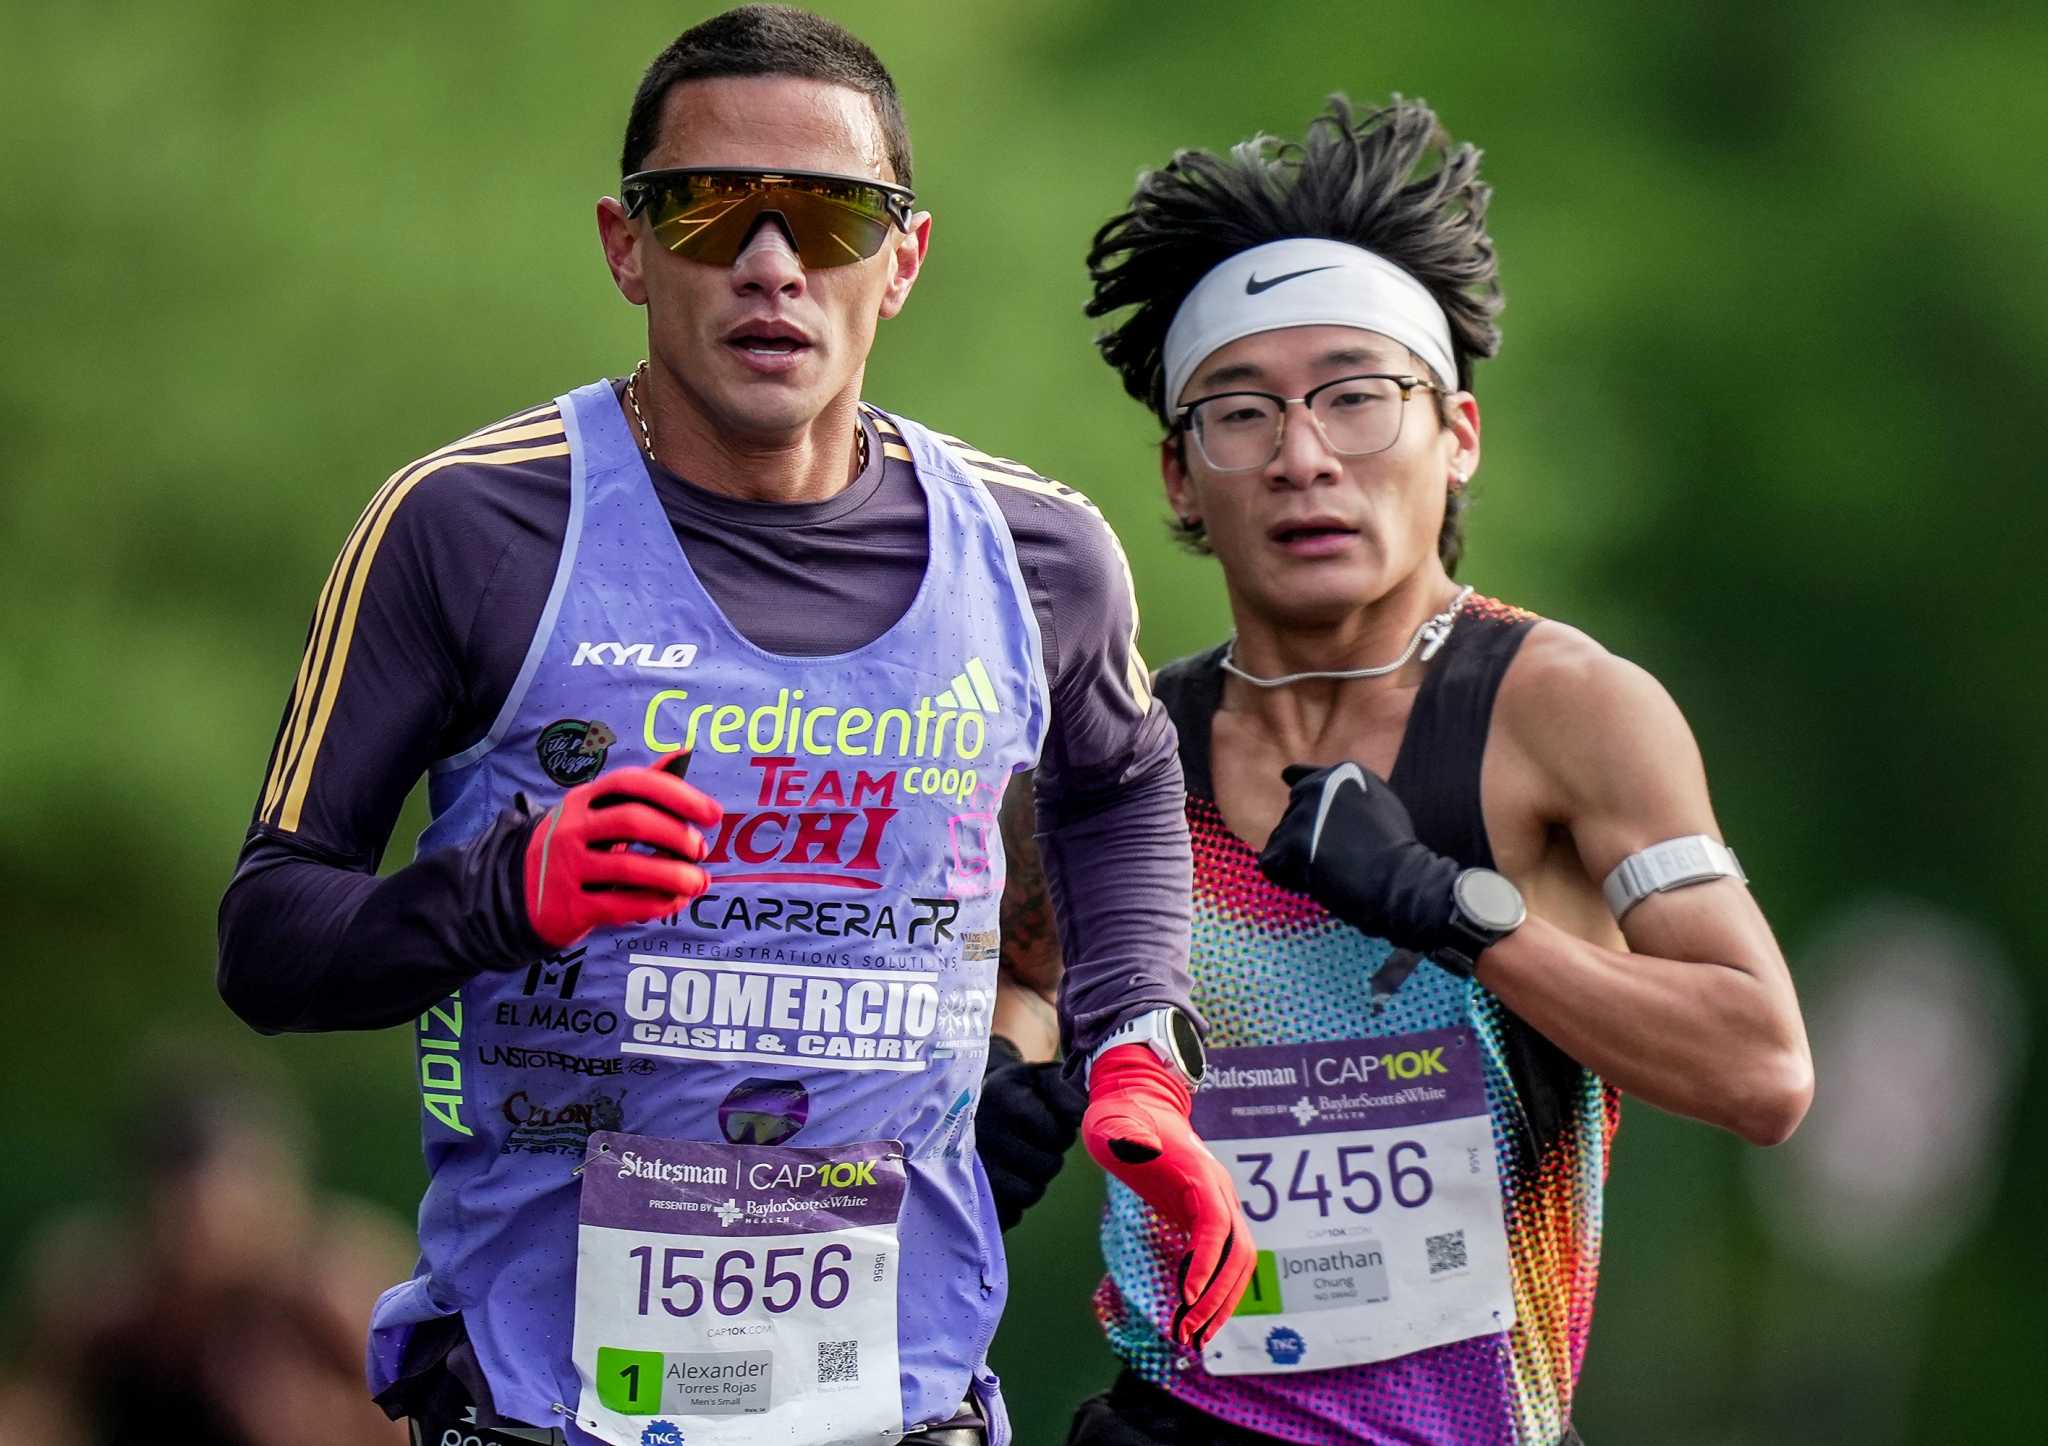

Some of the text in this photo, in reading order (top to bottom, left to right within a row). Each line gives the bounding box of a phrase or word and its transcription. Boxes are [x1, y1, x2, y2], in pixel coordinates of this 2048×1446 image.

[642, 688, 986, 760] Credicentro
[749, 757, 898, 808] TEAM
[903, 766, 977, 804] coop
[701, 808, 899, 869] ICHI
[690, 895, 960, 945] CARRERA PR
[614, 938, 957, 969] YOUR REGISTRATIONS SOLUTINS
[496, 1003, 618, 1036] EL MAGO
[623, 965, 939, 1038] COMERCIO
[632, 1022, 925, 1061] CASH & CARRY
[420, 988, 474, 1137] ADIZ
[479, 1046, 624, 1077] UNSTOPPABLE
[1200, 1046, 1449, 1092] Statesman CAP10K
[617, 1151, 879, 1190] Statesman CAP10K
[1236, 1140, 1434, 1223] 3456
[649, 1199, 712, 1212] PRESENTED BY
[629, 1243, 853, 1319] 15656
[873, 1253, 886, 1283] 15656
[1281, 1249, 1383, 1278] Jonathan
[1313, 1276, 1355, 1290] Chung
[706, 1324, 774, 1338] CAP10K.COM
[619, 1360, 769, 1403] 1 Alexander
[677, 1381, 757, 1396] Torres Rojas
[717, 1396, 741, 1406] Small
[647, 1432, 676, 1445] TKC
